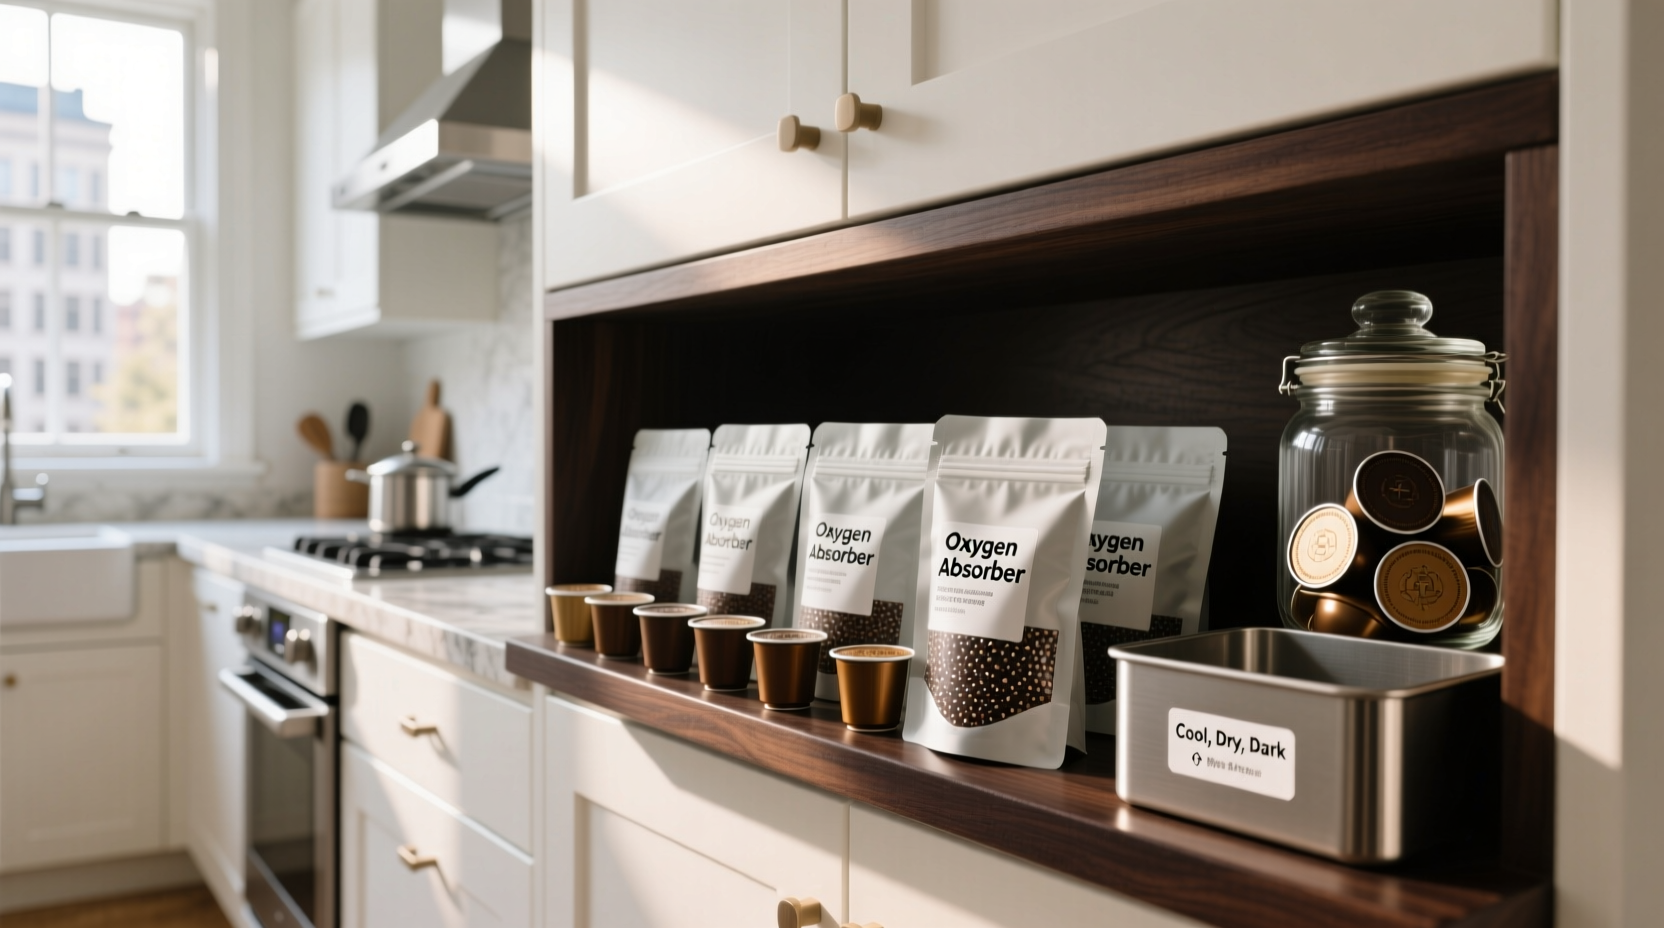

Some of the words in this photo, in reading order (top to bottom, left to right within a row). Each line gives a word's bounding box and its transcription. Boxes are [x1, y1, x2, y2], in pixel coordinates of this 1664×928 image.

[815, 521, 872, 545] Oxygen
[1088, 533, 1144, 553] xygen
[809, 543, 875, 566] Absorber
[945, 531, 1018, 560] Oxygen
[938, 556, 1026, 584] Absorber
[1086, 554, 1152, 577] sorber
[1175, 722, 1212, 748] Cool,
[1216, 729, 1245, 755] Dry,
[1249, 736, 1286, 761] Dark
